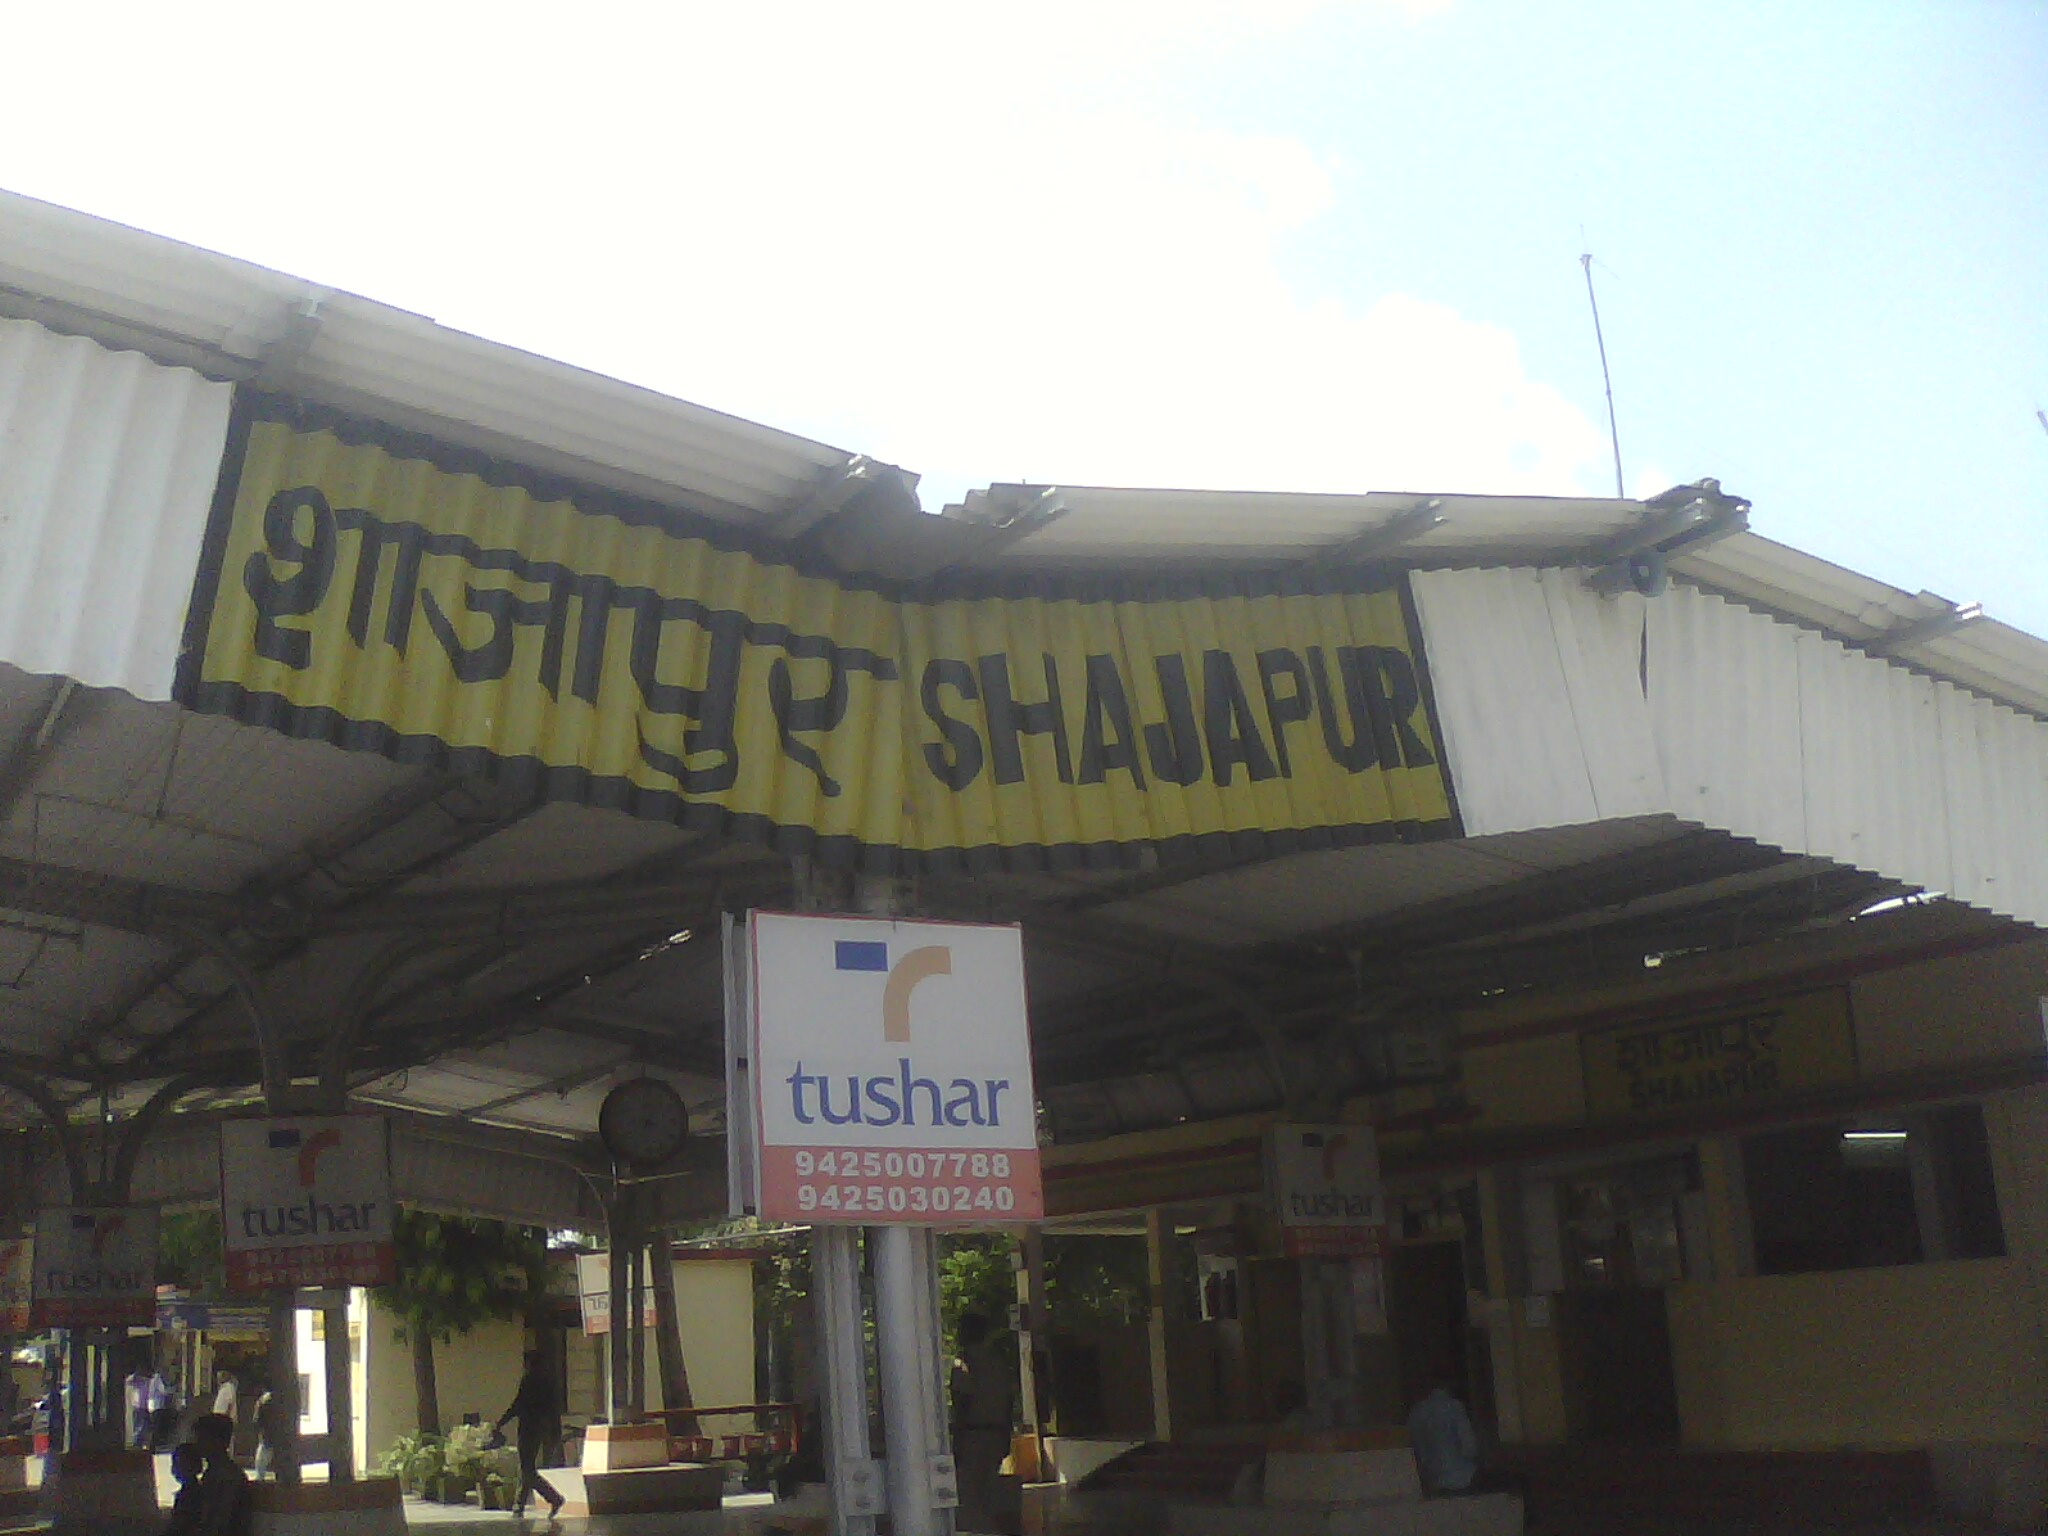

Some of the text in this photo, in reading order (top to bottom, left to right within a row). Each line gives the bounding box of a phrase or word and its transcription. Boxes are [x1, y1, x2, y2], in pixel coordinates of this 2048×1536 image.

[243, 485, 898, 797] शाजापुर
[920, 645, 1436, 792] SHAJAPUR
[785, 1058, 1010, 1128] tushar
[1630, 1059, 1781, 1107] SHAJAPUR
[795, 1151, 1011, 1179] 9425007788
[242, 1192, 376, 1237] tushar
[797, 1184, 1015, 1213] 9425030240
[1290, 1187, 1375, 1217] tushar
